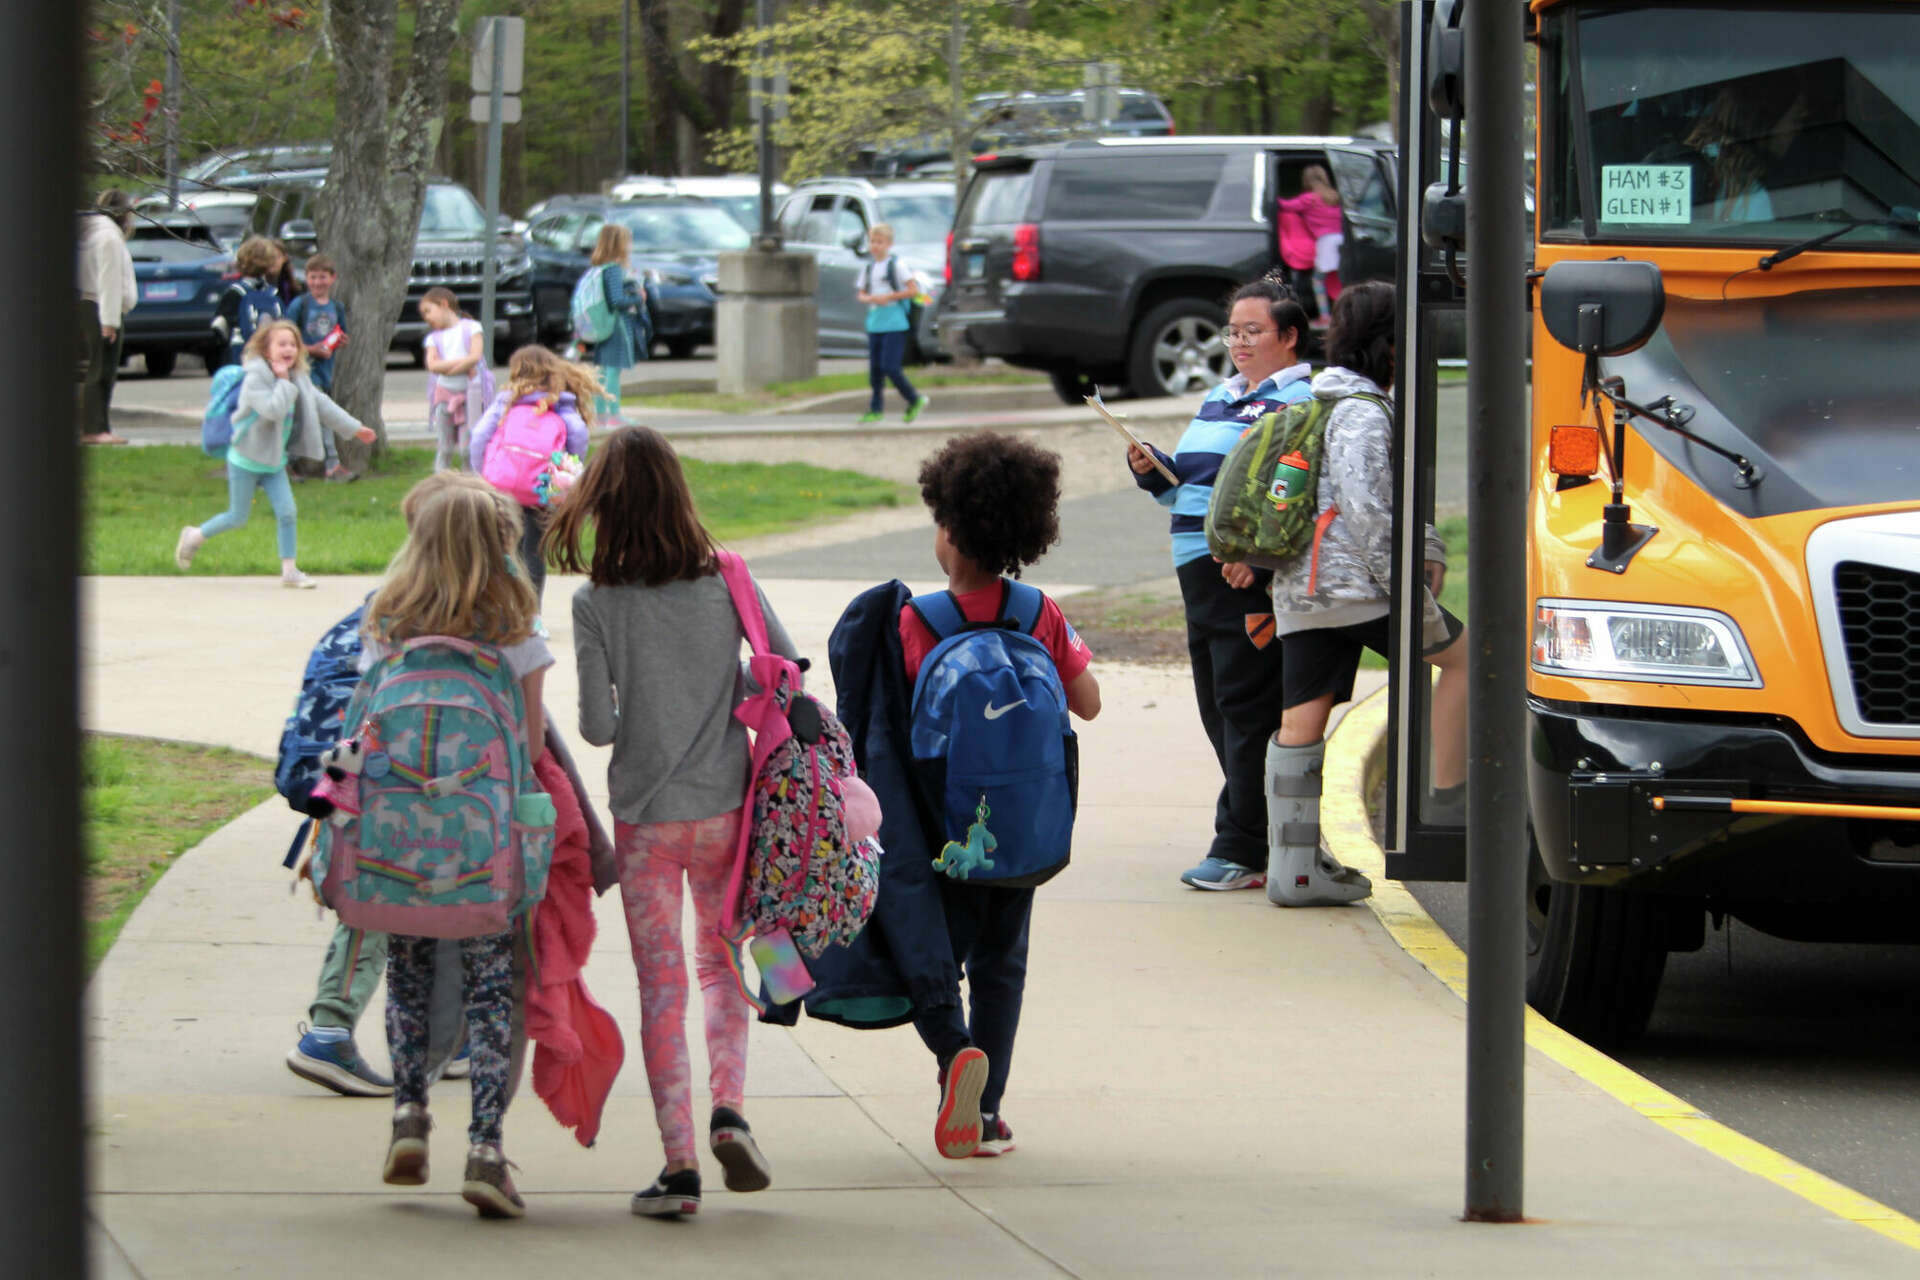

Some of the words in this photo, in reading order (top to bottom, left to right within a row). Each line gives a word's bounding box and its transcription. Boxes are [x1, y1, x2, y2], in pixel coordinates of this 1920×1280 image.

[1608, 169, 1650, 189] HAM
[1657, 171, 1685, 190] #3
[1607, 198, 1654, 215] GLEN
